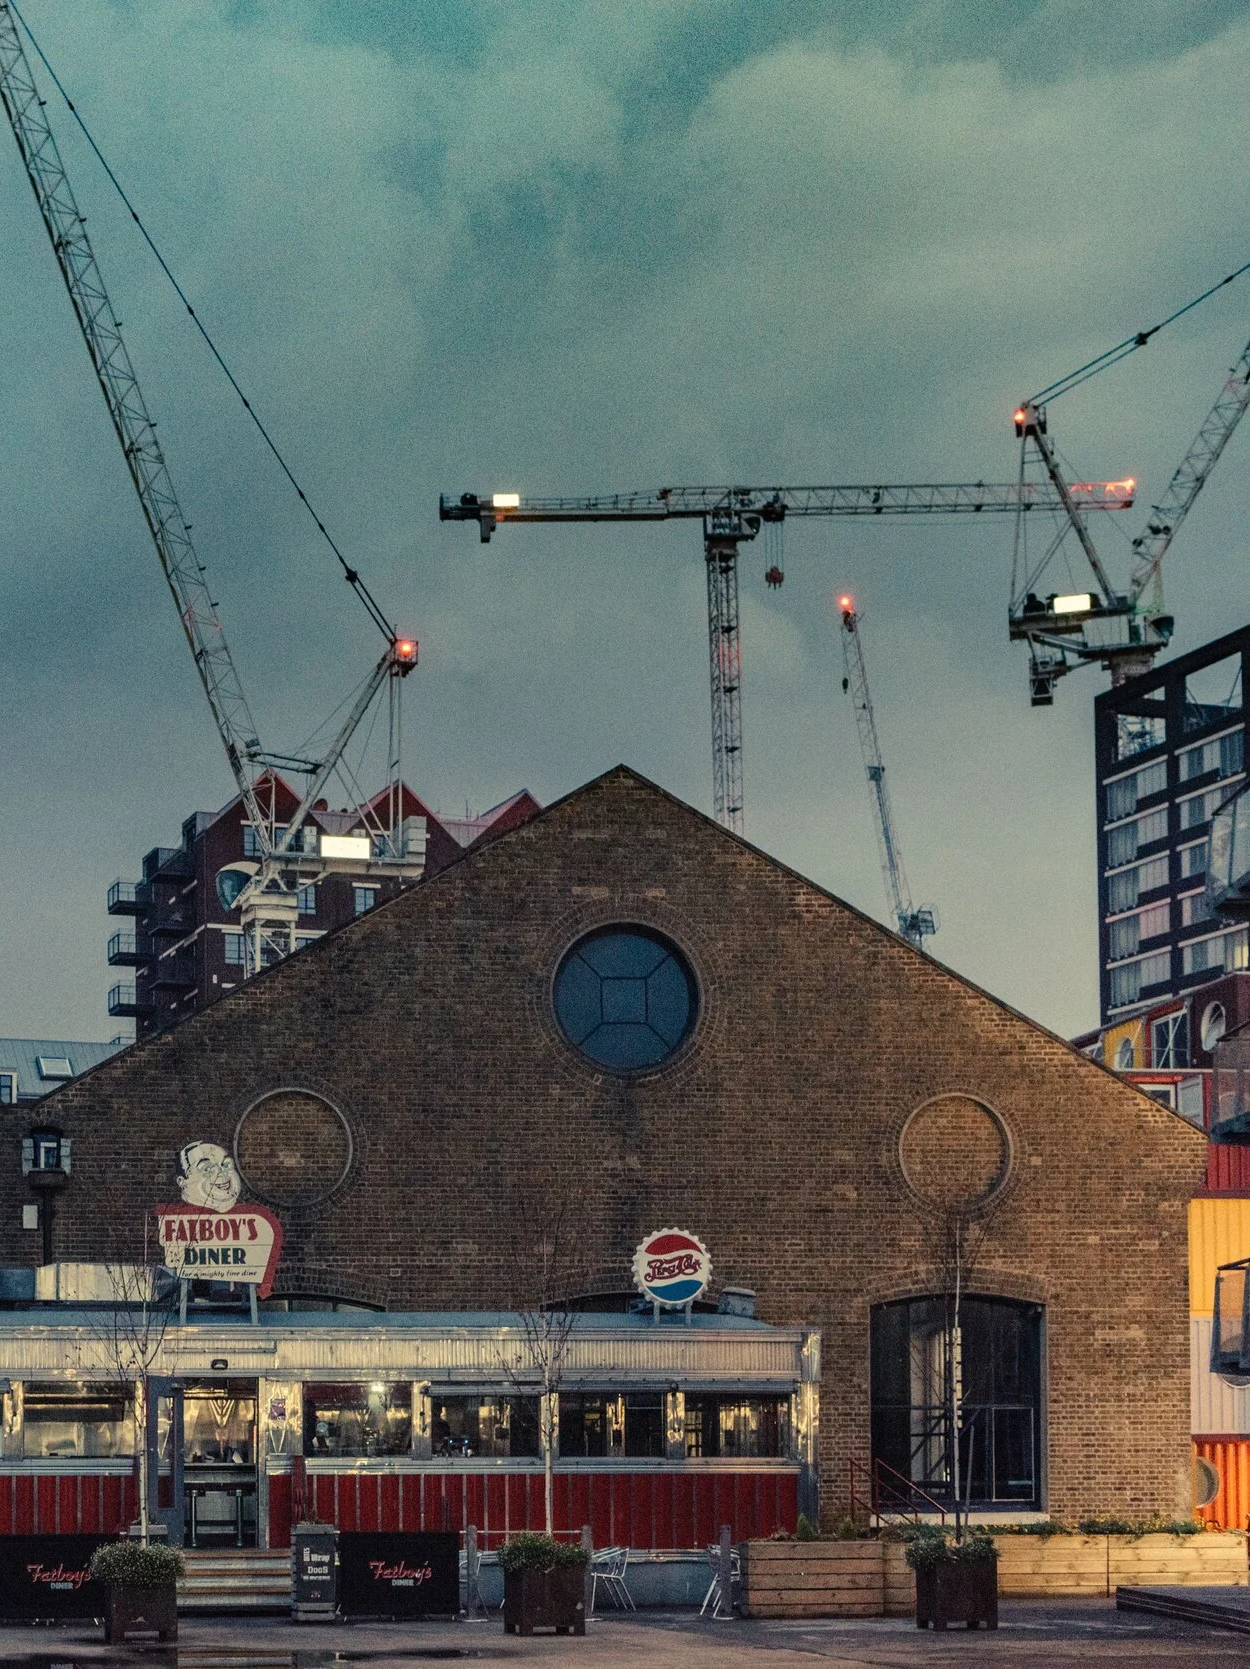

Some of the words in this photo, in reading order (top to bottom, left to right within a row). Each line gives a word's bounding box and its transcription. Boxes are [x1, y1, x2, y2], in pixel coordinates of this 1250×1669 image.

[165, 1218, 258, 1242] FATBOY'S
[184, 1247, 246, 1265] DINER
[200, 1270, 225, 1278] mighty
[226, 1269, 240, 1277] fine
[26, 1563, 91, 1589] Fatboy's
[367, 1561, 431, 1586] Fatboy's
